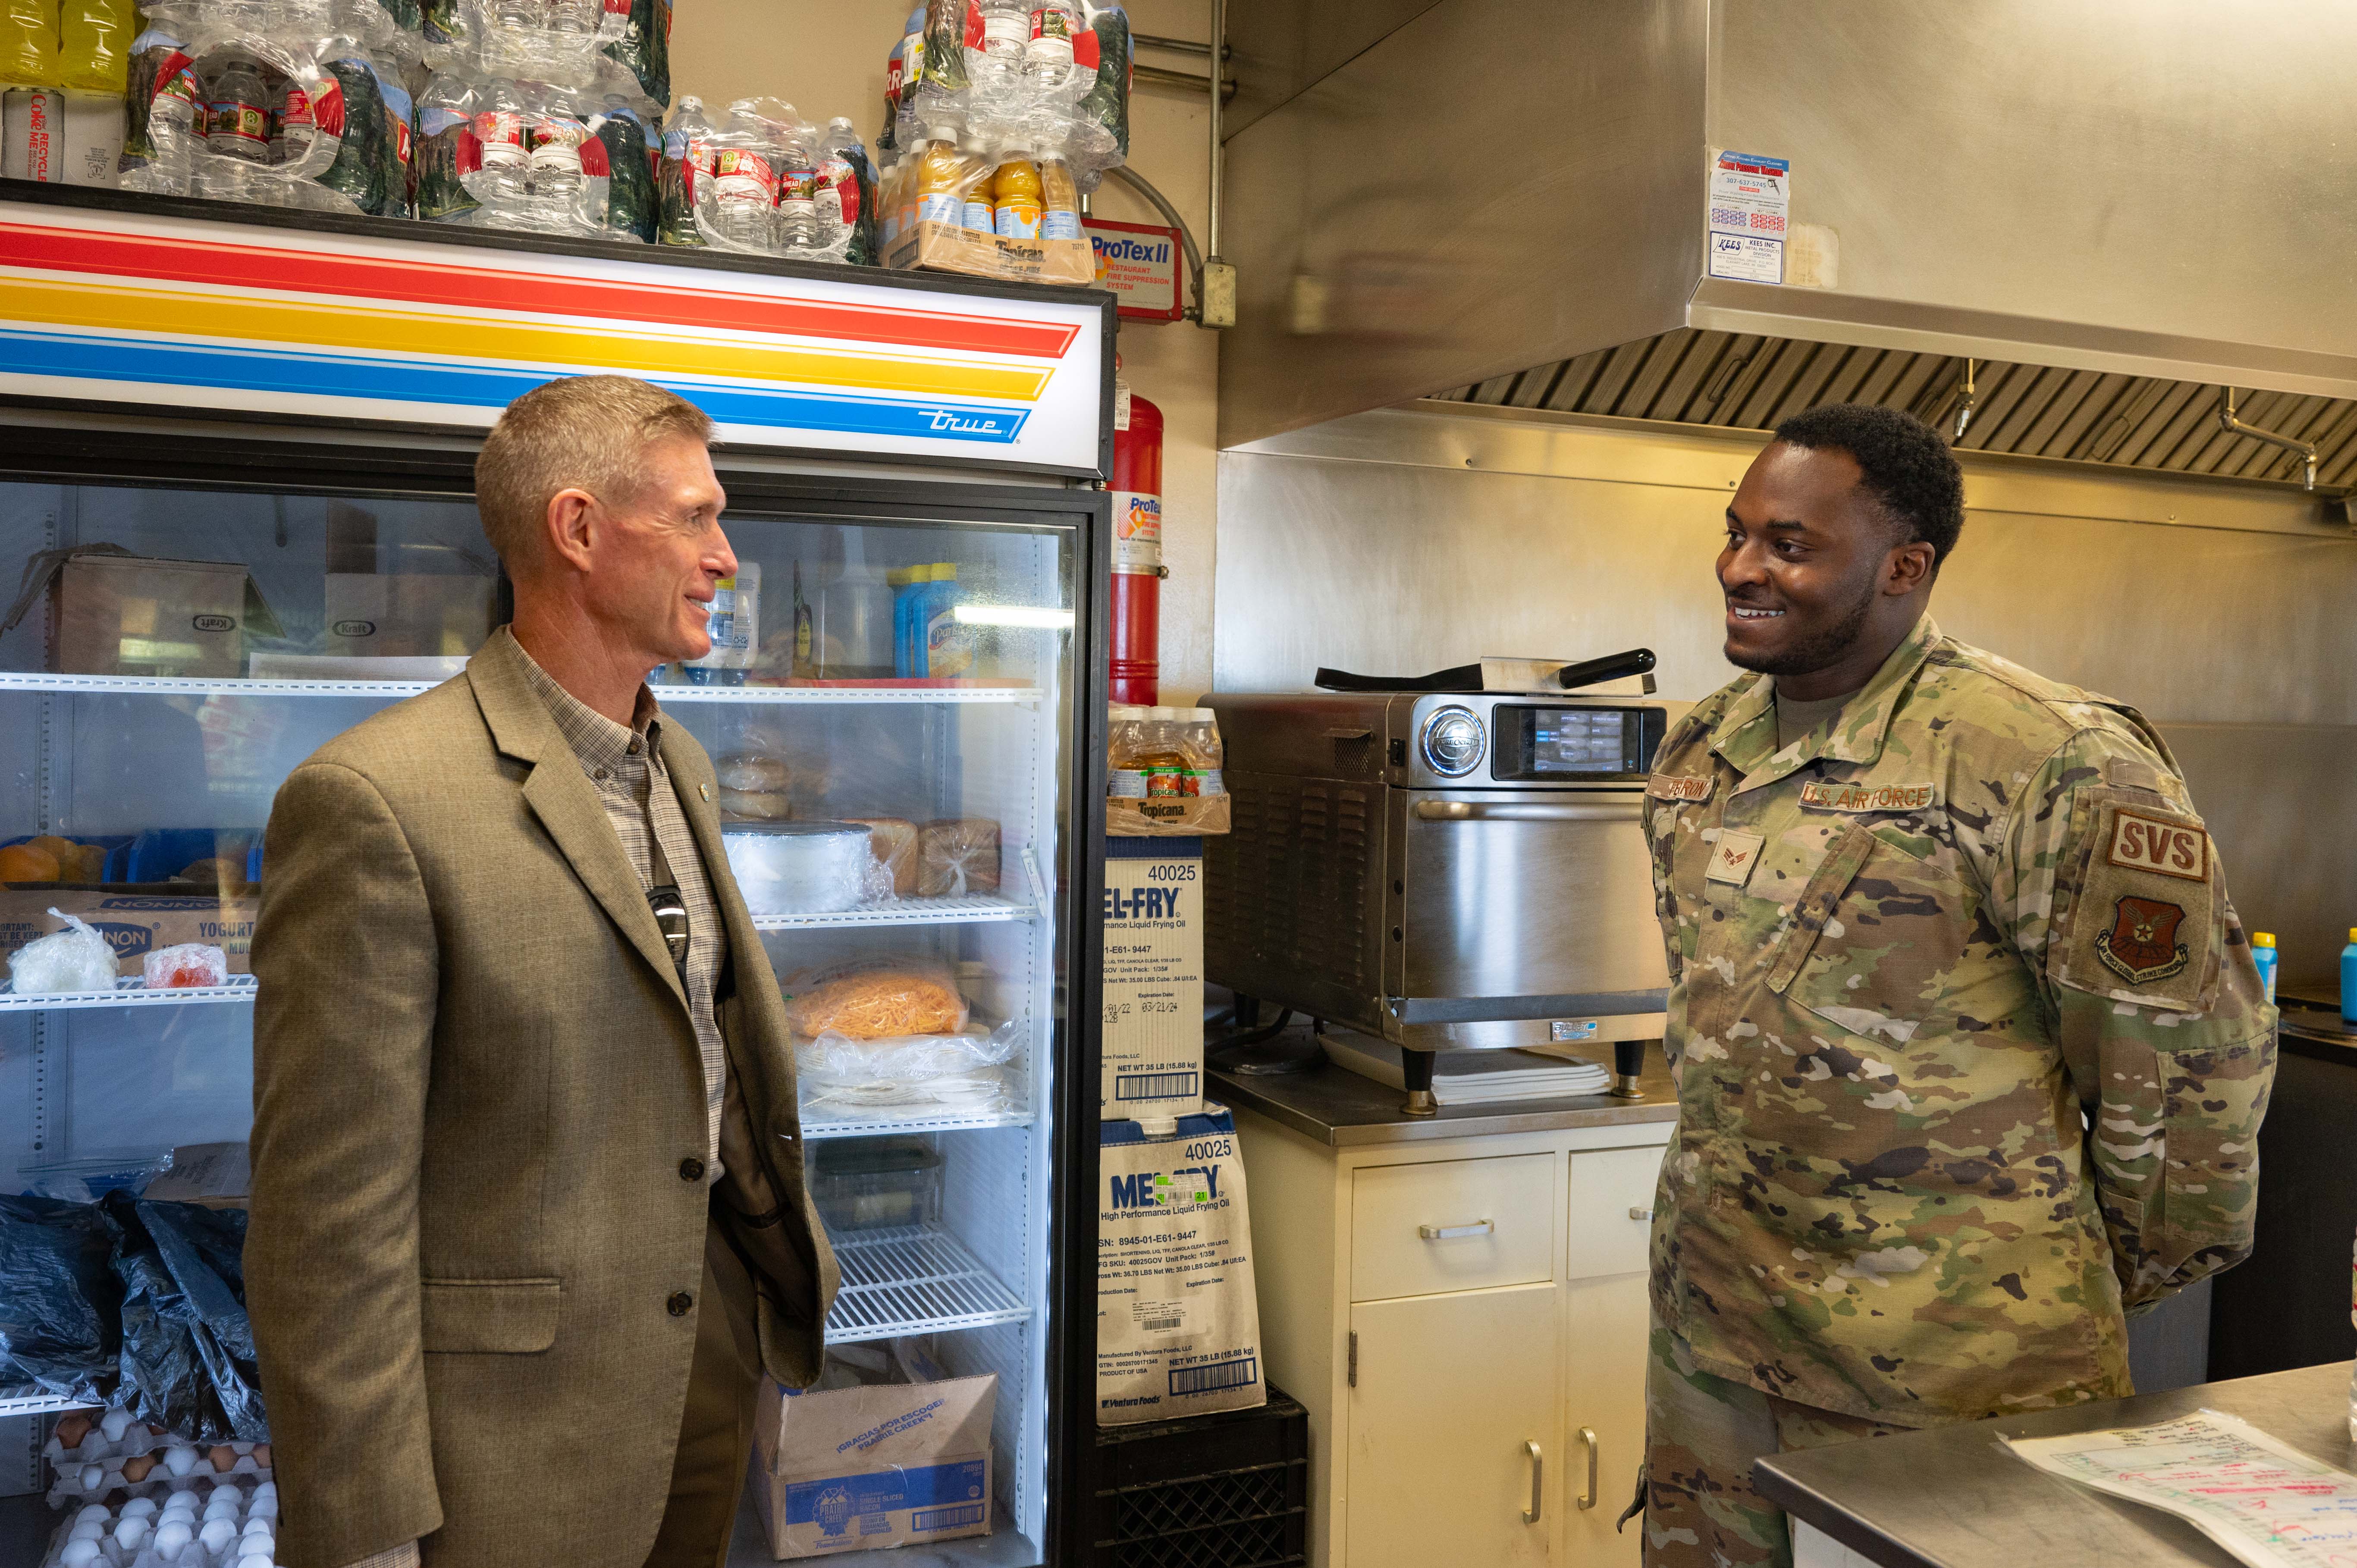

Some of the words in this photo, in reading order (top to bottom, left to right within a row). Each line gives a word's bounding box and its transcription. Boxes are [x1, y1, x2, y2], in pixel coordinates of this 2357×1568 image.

[31, 94, 46, 130] Coke
[29, 132, 39, 149] ME
[38, 133, 49, 182] RECYCLE
[1736, 162, 1760, 174] PRESSURE
[1761, 165, 1783, 177] WASHING
[1726, 177, 1767, 188] 307-637-5745
[1718, 238, 1741, 251] KEES
[1107, 264, 1151, 274] RESTAURANT
[1106, 282, 1133, 290] SYSTEM
[1123, 274, 1169, 285] SUPPRESSION
[918, 410, 1003, 434] true
[201, 618, 227, 629] Kraft
[342, 624, 366, 633] Kraft
[1149, 788, 1178, 797] Tropicana
[1802, 784, 1831, 806] U.S.
[1836, 790, 1866, 809] AIR
[1871, 787, 1929, 807] FORCE
[1138, 802, 1185, 819] Tropicana
[2120, 822, 2195, 870] SVS
[1148, 865, 1196, 881] 40025
[1104, 887, 1180, 919] EL-FRY
[0, 923, 34, 931] ORTANT:
[199, 922, 254, 938] YOGURT
[1130, 921, 1151, 929] Liquid
[1153, 921, 1174, 929] Frying
[105, 931, 146, 946] NON
[229, 943, 250, 954] MUL
[1185, 1139, 1231, 1161] 40025
[1101, 1212, 1119, 1221] High
[1121, 1208, 1171, 1219] Performance
[1173, 1205, 1195, 1216] Liquid
[1196, 1201, 1218, 1213] Frying
[1220, 1198, 1230, 1207] Oil
[1099, 1239, 1114, 1247] SN:
[1177, 1230, 1196, 1240] 9447
[1129, 1257, 1162, 1266] 40025GOV
[1199, 1250, 1215, 1258] 1/35#
[1176, 1265, 1190, 1273] 35.00
[1204, 1261, 1220, 1270] Cube:
[1186, 1279, 1211, 1288] Expiration
[1098, 1351, 1133, 1359] Manufactured
[1169, 1358, 1185, 1366] NET
[1186, 1356, 1198, 1364] WT
[1221, 1349, 1243, 1360] (15.88
[1243, 1347, 1254, 1356] kg)
[1110, 1398, 1138, 1408] Ventura
[880, 1418, 901, 1430] POR
[857, 1430, 894, 1450] PRAIRIE
[815, 1540, 853, 1549] Foundations
